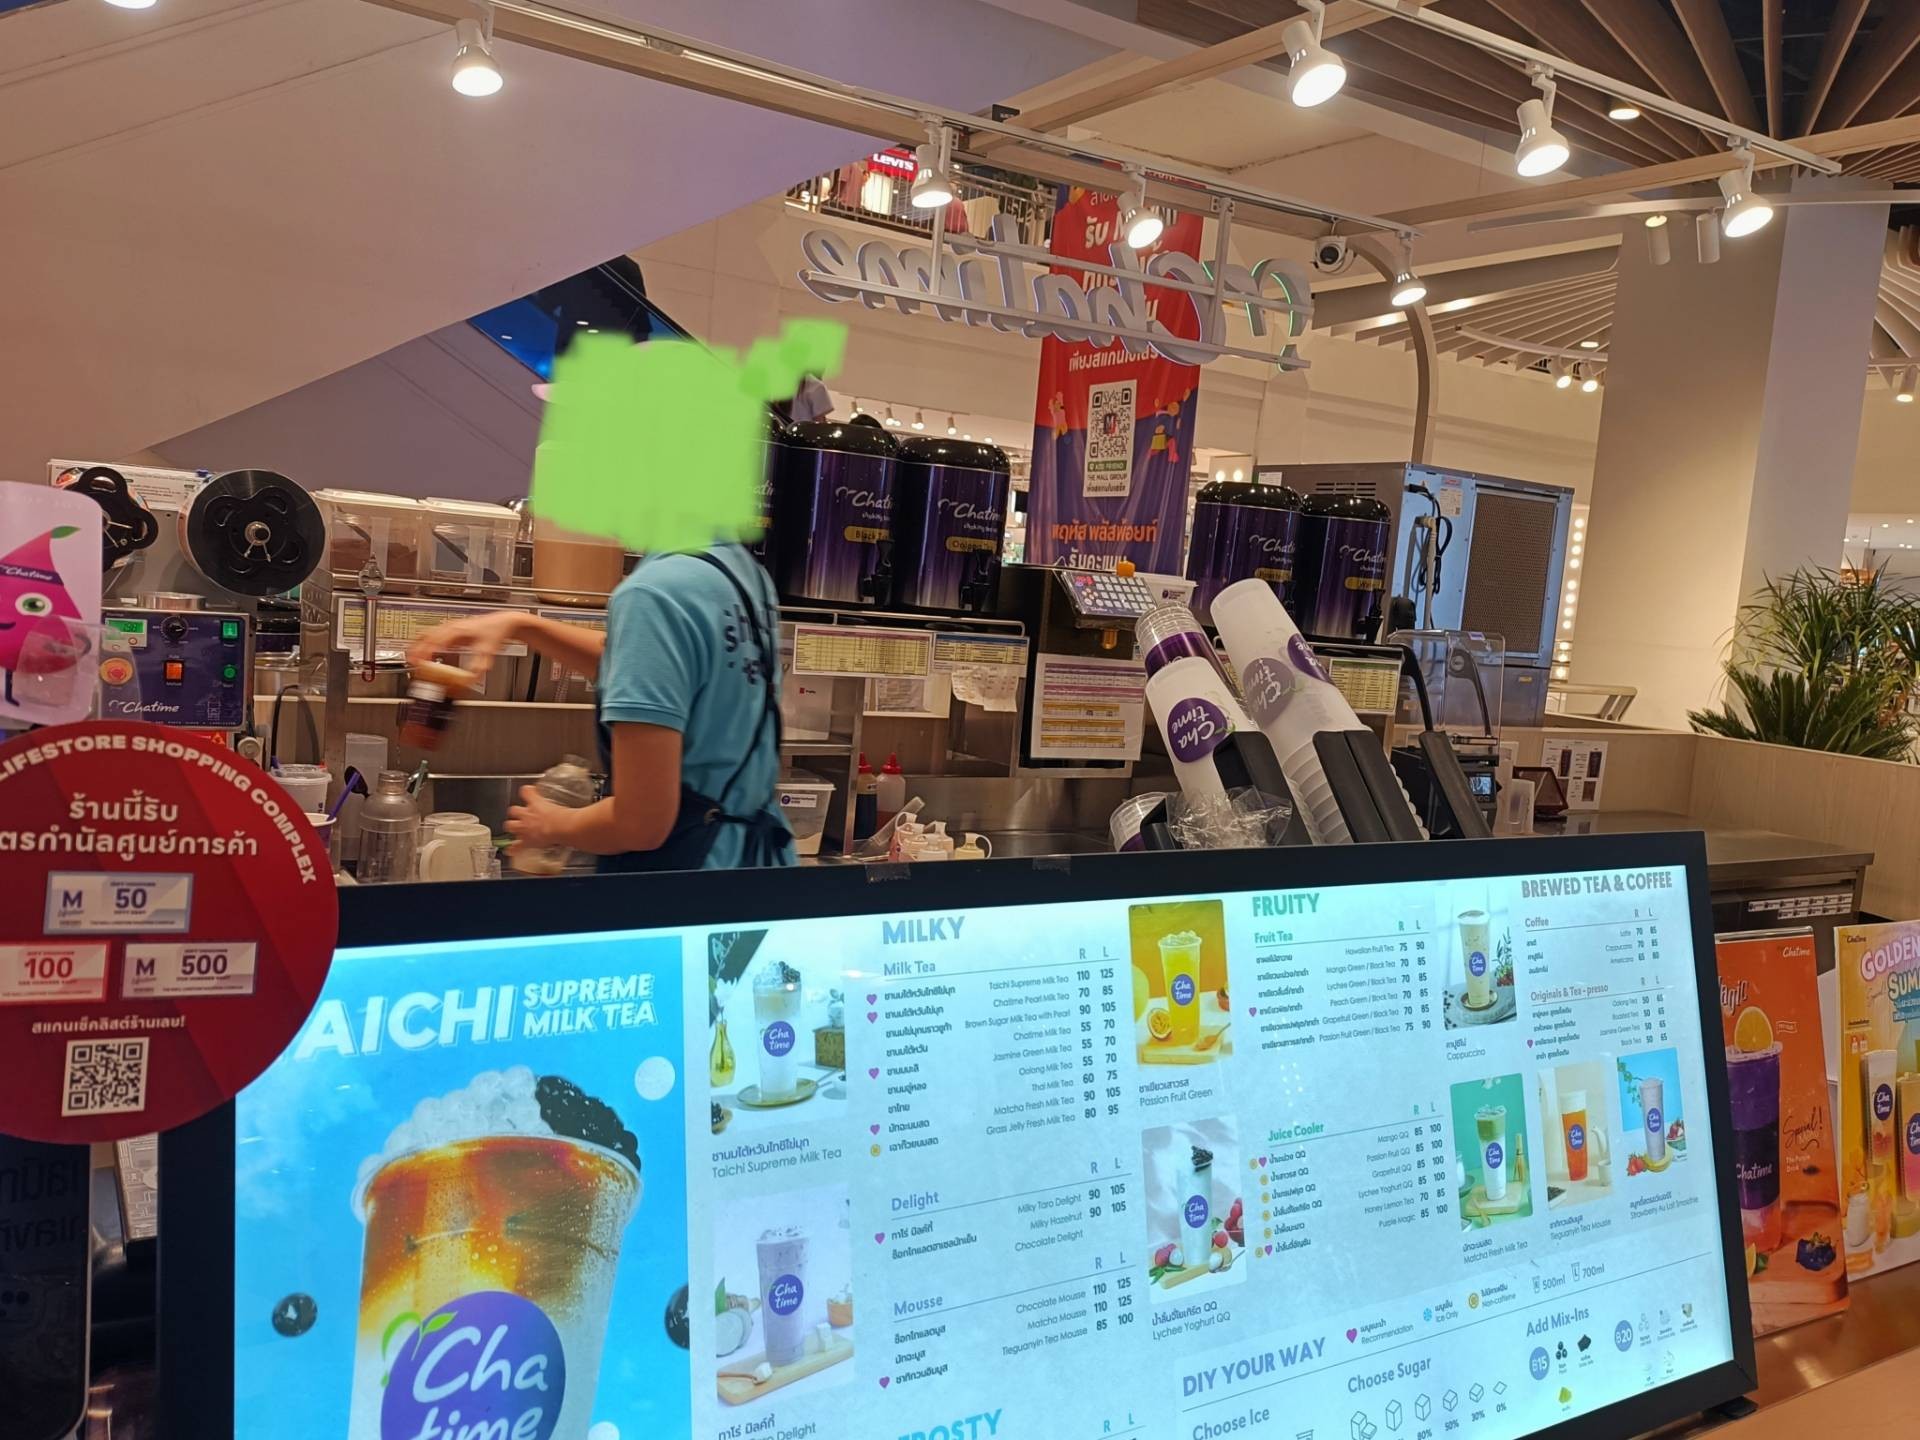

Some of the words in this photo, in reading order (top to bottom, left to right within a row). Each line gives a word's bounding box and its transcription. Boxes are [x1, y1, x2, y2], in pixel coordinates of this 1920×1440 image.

[5, 564, 53, 581] Chatime
[123, 701, 180, 713] Chatime
[69, 789, 178, 822] ร้านนี้รับ
[132, 736, 252, 792] SHOPPING
[250, 788, 317, 884] COMPLEX
[62, 890, 83, 909] M
[114, 888, 148, 909] 50
[1522, 880, 1581, 898] BREWED
[1584, 875, 1612, 893] TEA
[1614, 874, 1624, 891] &
[1626, 871, 1672, 890] COFFEE
[1252, 892, 1320, 917] FRUITY
[882, 916, 965, 944] MILKY
[1525, 917, 1549, 928] Coffee
[24, 957, 73, 979] 100
[136, 958, 155, 976] M
[180, 955, 228, 977] 500
[884, 962, 911, 976] Milk
[914, 960, 936, 973] Tea
[1079, 948, 1086, 960] R
[1103, 947, 1109, 957] L
[1861, 935, 1920, 980] GOLDEN
[993, 998, 1023, 1008] Chatime
[1025, 996, 1042, 1005] Pearl
[1078, 987, 1090, 998] 70
[1102, 985, 1114, 996] 85
[1721, 976, 1748, 1017] agic
[1888, 967, 1920, 1001] SUM
[295, 984, 515, 1059] AICHI
[523, 972, 653, 1008] SUPREME
[523, 1011, 597, 1038] MILK
[602, 1002, 657, 1029] TEA
[1079, 1004, 1091, 1015] 90
[1101, 1002, 1116, 1013] 105
[769, 1028, 789, 1041] Cha
[1081, 1022, 1092, 1032] 55
[1104, 1019, 1115, 1030] 70
[1081, 1039, 1092, 1050] 55
[1104, 1036, 1116, 1047] 70
[1084, 1107, 1096, 1119] 80
[1108, 1104, 1119, 1115] 95
[1140, 1094, 1168, 1108] Passion
[1170, 1091, 1187, 1103] Fruit
[1188, 1088, 1213, 1100] Green
[1268, 1128, 1292, 1143] Juice
[1294, 1122, 1325, 1138] Cooler
[1413, 1105, 1419, 1116] R
[1415, 1142, 1424, 1153] 85
[1431, 1139, 1443, 1150] 100
[712, 1162, 745, 1178] Taichi
[748, 1156, 797, 1173] Supreme
[800, 1151, 820, 1163] Milk
[822, 1148, 842, 1159] Tea
[891, 1191, 939, 1212] Delight
[1091, 1162, 1098, 1174] R
[1115, 1158, 1120, 1169] L
[1030, 1219, 1049, 1230] Milky
[1050, 1211, 1082, 1226] Hazelnut
[1089, 1206, 1101, 1218] 90
[1111, 1201, 1126, 1213] 105
[1015, 1235, 1055, 1252] Chocolate
[1056, 1230, 1083, 1243] Delight
[894, 1296, 943, 1316] Mousse
[1095, 1257, 1102, 1269] R
[1120, 1252, 1126, 1264] L
[1542, 1275, 1566, 1290] 500ml
[1582, 1264, 1605, 1279] 700ml
[1016, 1297, 1057, 1314] Chocolate
[1058, 1290, 1086, 1305] Mousse
[1093, 1283, 1107, 1296] 110
[1117, 1277, 1131, 1290] 125
[1027, 1316, 1058, 1331] Matcha
[1059, 1308, 1087, 1323] Mousse
[1094, 1301, 1108, 1313] 110
[1118, 1295, 1132, 1307] 125
[1153, 1324, 1183, 1341] Lychee
[1185, 1315, 1215, 1334] Yoghurt
[1216, 1311, 1231, 1324] QQ
[1526, 1318, 1549, 1337] Add
[1551, 1307, 1590, 1329] Mix-Ins
[1361, 1324, 1414, 1345] Recommendation
[412, 1324, 548, 1404] Cha
[1183, 1369, 1217, 1397] DIY
[1221, 1352, 1275, 1385] YOUR
[1279, 1337, 1326, 1368] WAY
[1348, 1370, 1394, 1393] Choose
[1397, 1357, 1431, 1381] Sugar
[1496, 1403, 1507, 1412] 0%
[414, 1406, 545, 1440] time
[776, 1422, 816, 1440] Delight
[899, 1409, 1001, 1440] OSTY
[1103, 1420, 1110, 1433] R
[1129, 1412, 1134, 1425] L
[1193, 1412, 1247, 1440] Choose
[1249, 1408, 1270, 1424] Ice
